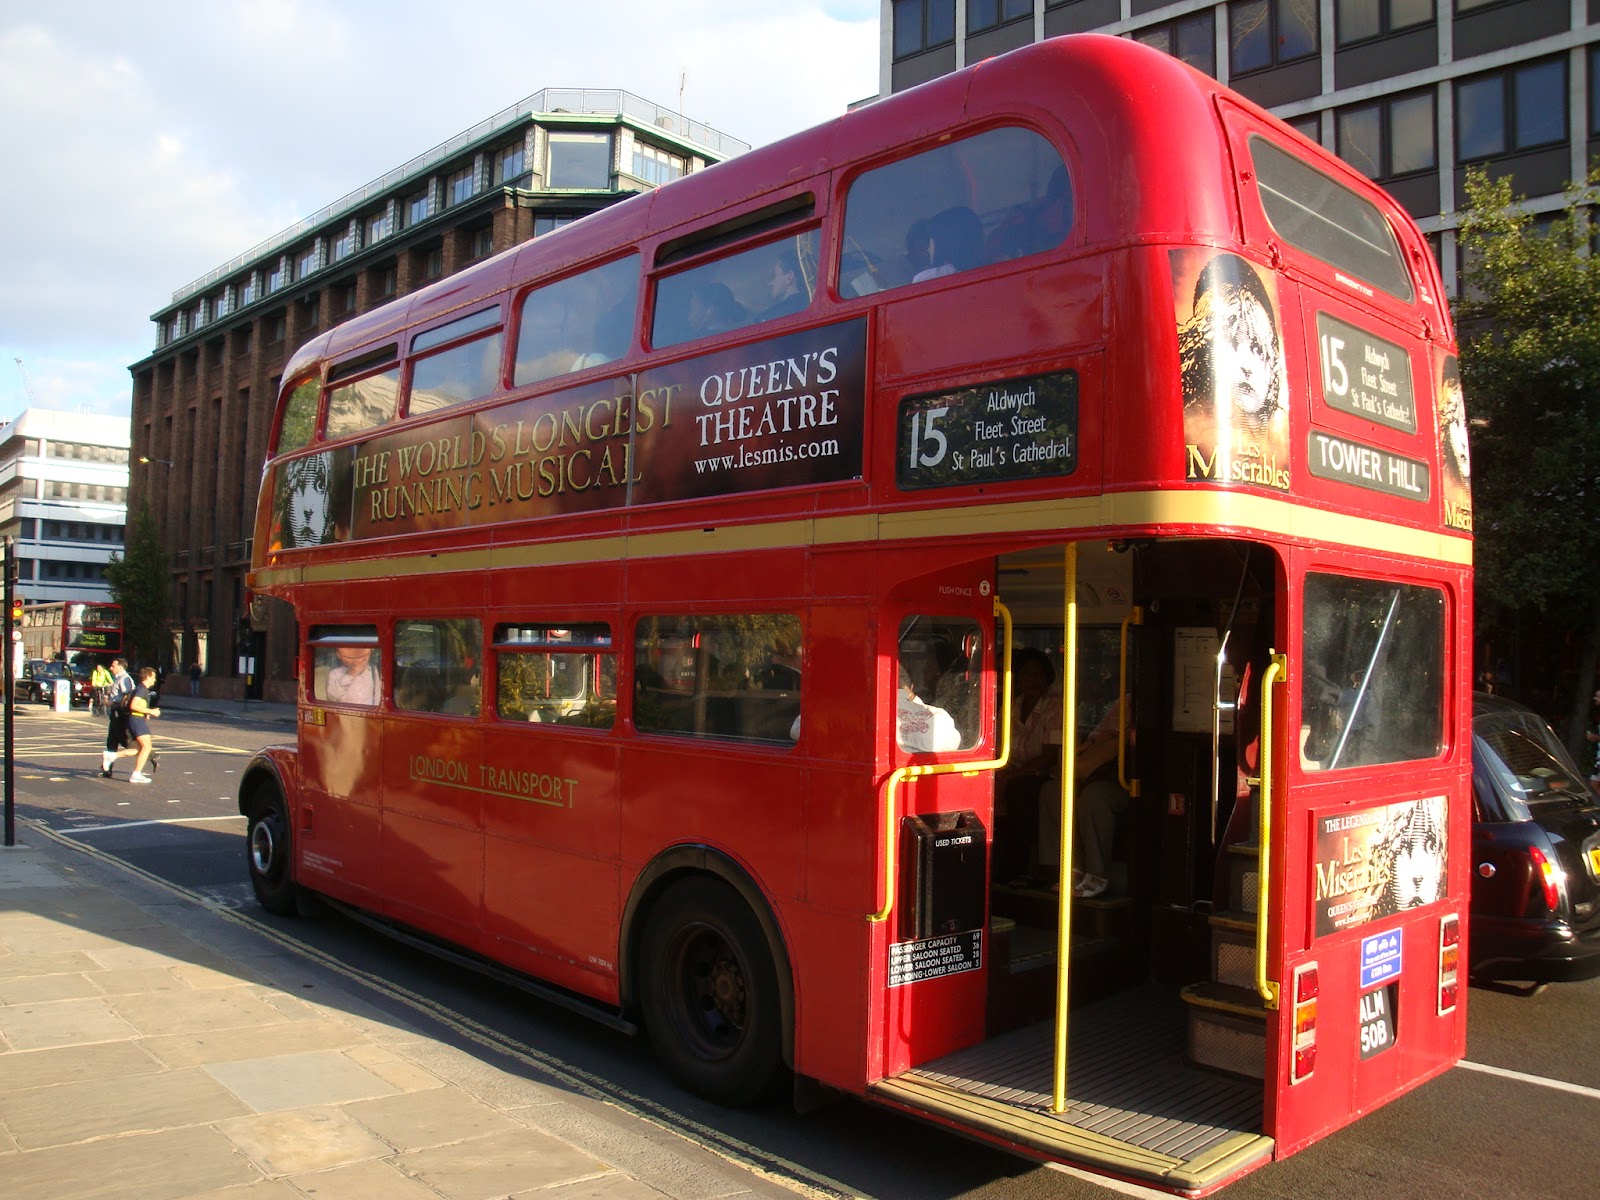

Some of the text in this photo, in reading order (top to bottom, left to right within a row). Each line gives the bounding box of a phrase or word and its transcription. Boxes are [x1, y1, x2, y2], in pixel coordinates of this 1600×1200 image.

[1321, 334, 1349, 397] 15
[1364, 344, 1390, 373] Aldwych
[700, 347, 838, 407] QUEEN'S
[1361, 366, 1398, 397] Fleet Street
[987, 386, 1036, 414] Aldwych
[1350, 388, 1360, 408] St
[1361, 391, 1382, 415] Paul's
[695, 389, 840, 447] THEATRE
[975, 415, 1047, 441] Fleet Street
[352, 384, 682, 489] THE WORLD'S LONGEST
[909, 406, 950, 469] 15
[694, 438, 840, 474] www.lesmis.com
[951, 437, 1071, 471] St Paul's Cathedral
[1316, 435, 1422, 493] TOWER HILL
[370, 443, 643, 522] RUNNING MUSICAL
[938, 585, 973, 597] PUSH ONCE
[409, 754, 579, 809] LONDON TRANSPORT
[1324, 817, 1341, 833] THE
[935, 836, 972, 848] USED TICKETS
[1343, 836, 1364, 867] Les
[890, 932, 980, 956] PASSENGER CAPACITY 69
[890, 942, 980, 966] UPPER SALOON SEATED 36
[890, 951, 980, 975] LOWER SALOON SEATED 28
[947, 960, 972, 973] SALOON
[975, 959, 980, 967] 5
[1359, 992, 1386, 1023] ALM
[1360, 1022, 1388, 1052] 50B
